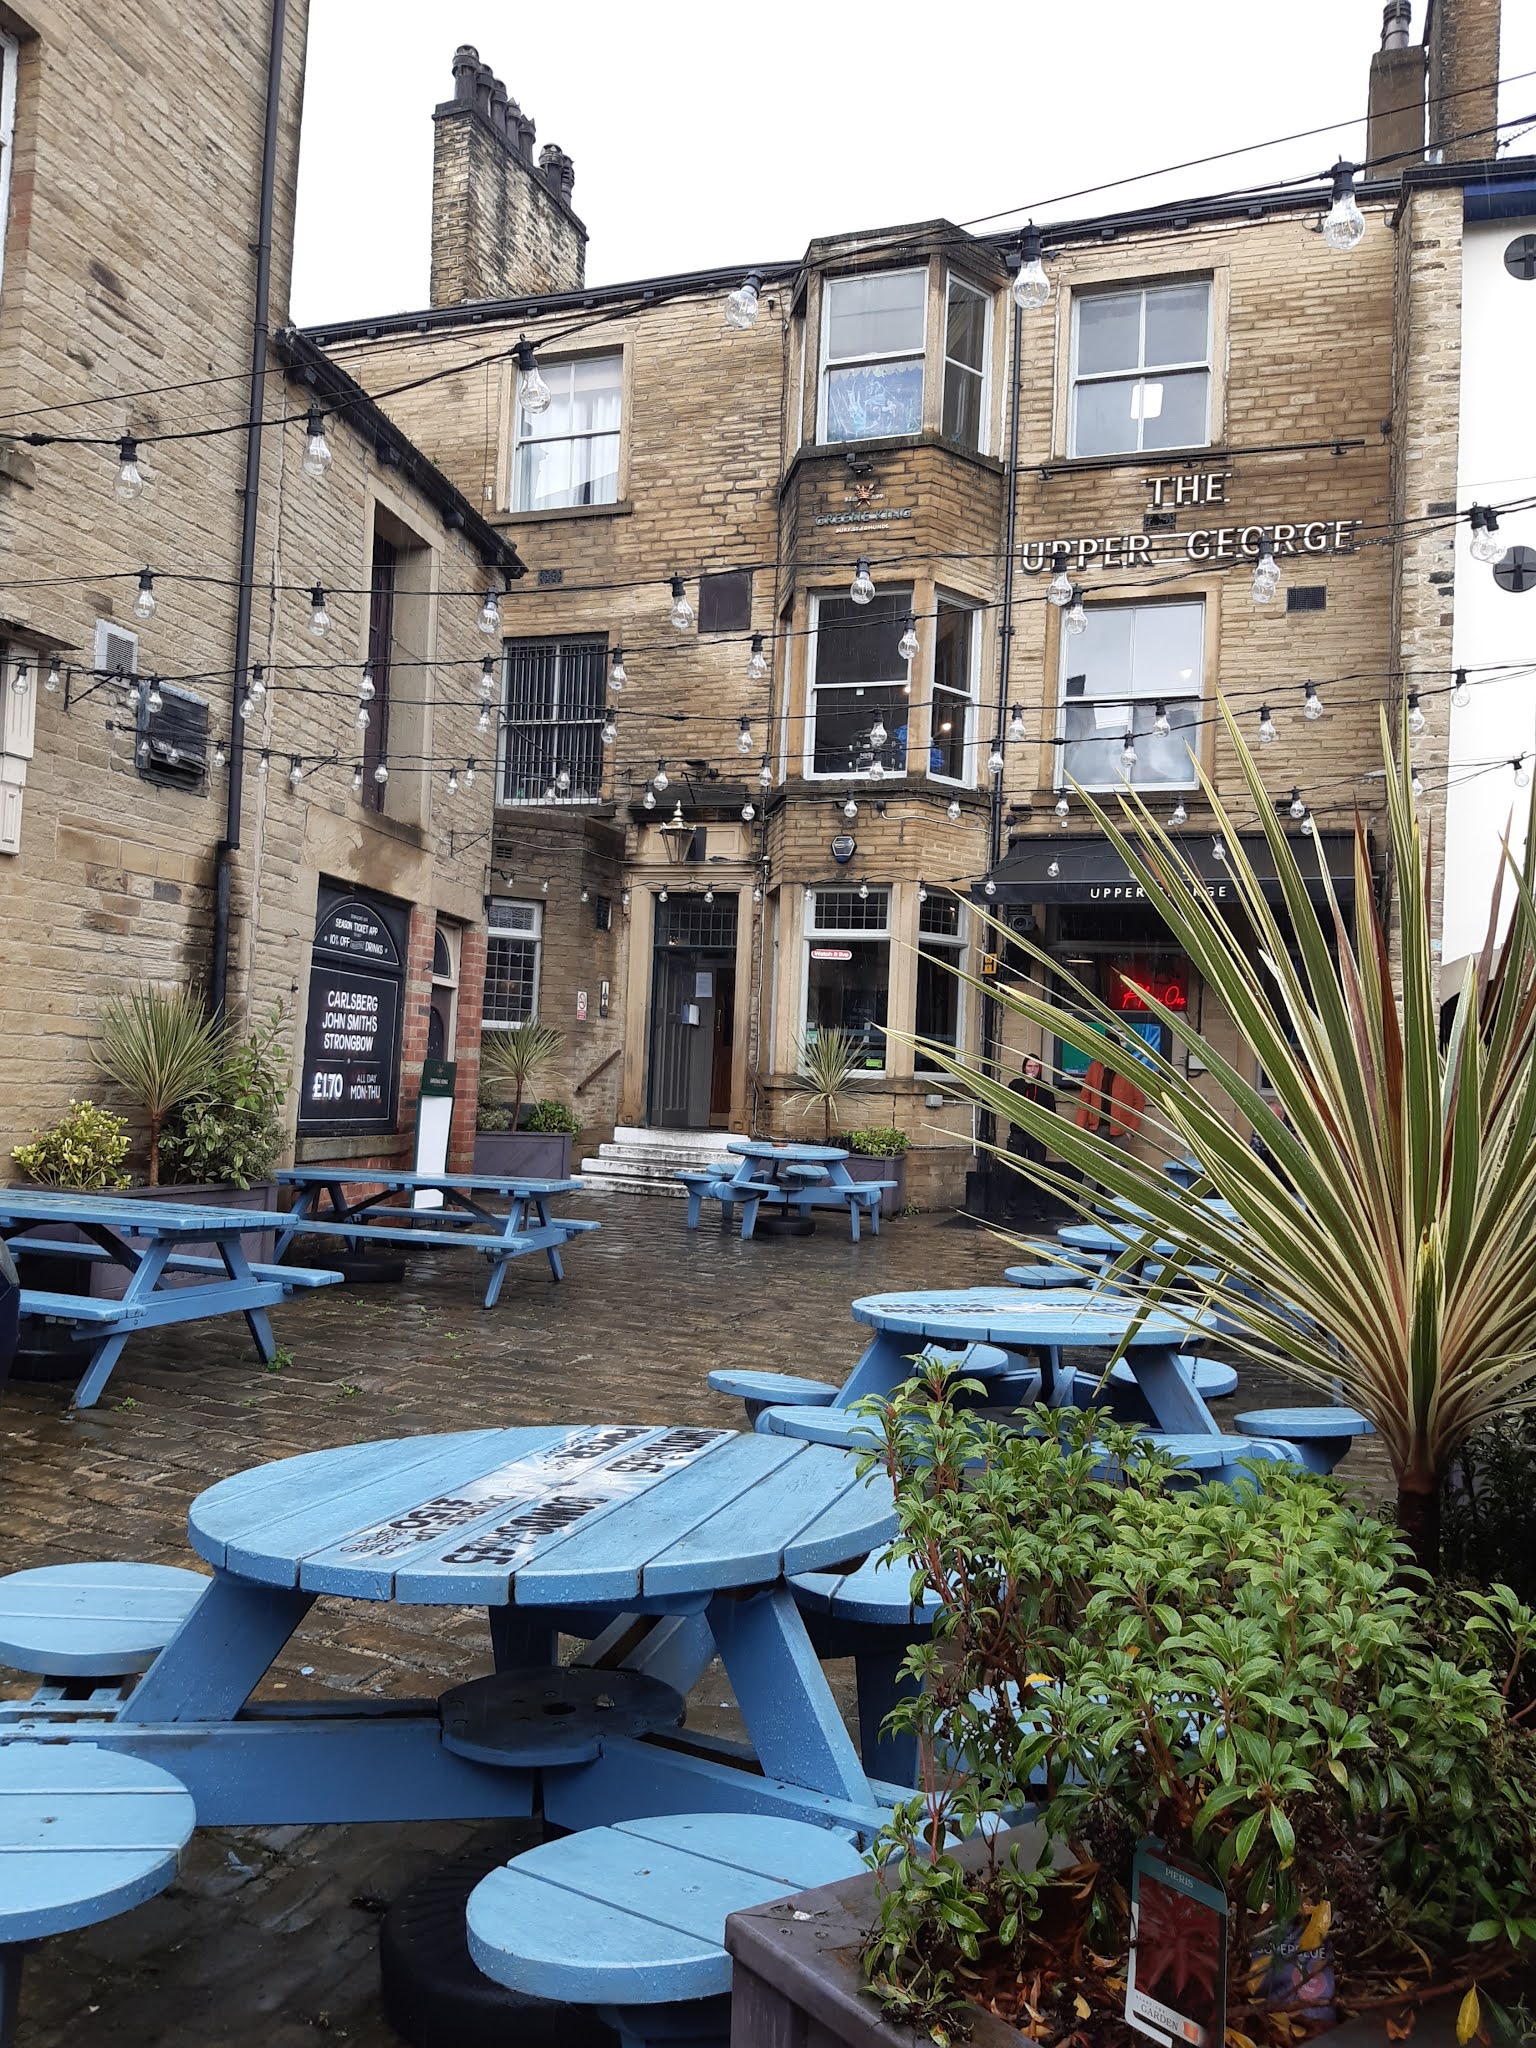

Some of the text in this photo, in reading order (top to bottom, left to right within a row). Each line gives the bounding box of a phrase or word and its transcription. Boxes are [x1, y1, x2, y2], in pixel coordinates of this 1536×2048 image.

[1146, 472, 1226, 508] THE
[815, 508, 912, 526] GREENE KING
[1021, 521, 1355, 575] UPPER GEORGE
[1090, 886, 1227, 899] UPPER RGE
[335, 917, 353, 930] SEASON
[353, 922, 369, 934] TICKET
[369, 926, 379, 936] APP
[340, 936, 351, 947] OFF
[365, 941, 384, 955] DRINKS
[328, 990, 379, 1012] CARLSBERG
[322, 1012, 378, 1032] JOHN SMITH'S
[324, 1033, 374, 1051] STRONGBOW
[313, 1072, 378, 1099] £1.70 ALL DAY
[554, 1427, 652, 1459] POKER
[642, 1429, 729, 1453] SHOTS
[605, 1459, 666, 1474] £5
[438, 1494, 518, 1526] DOUBLE
[494, 1495, 610, 1535] BOMBS
[410, 1528, 449, 1542] UP
[440, 1545, 516, 1565] £5
[1165, 1867, 1194, 1888] PIERIS
[1140, 2003, 1179, 2031] GARDEN
